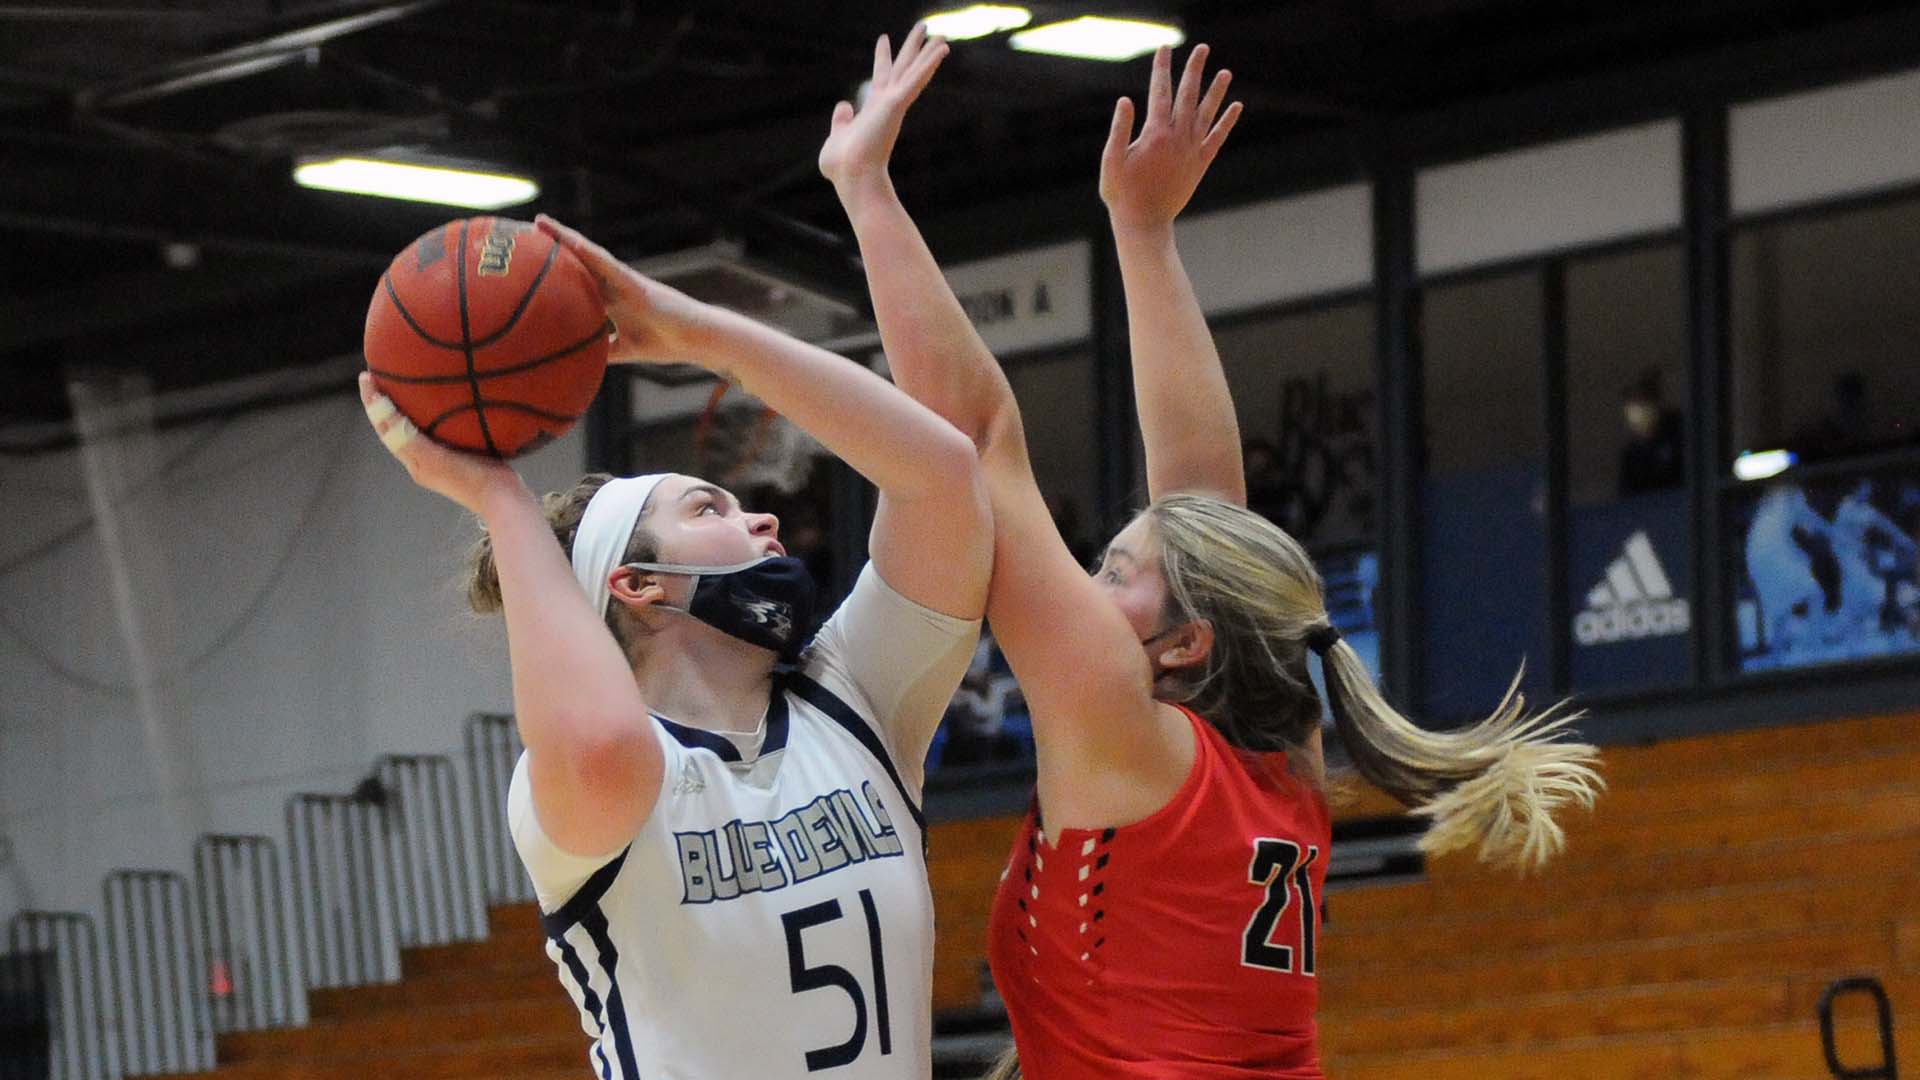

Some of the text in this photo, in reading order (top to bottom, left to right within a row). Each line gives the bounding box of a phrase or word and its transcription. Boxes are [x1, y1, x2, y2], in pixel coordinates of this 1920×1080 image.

[1574, 598, 1691, 645] adidas
[673, 819, 788, 905] BLUE
[1240, 837, 1318, 977] 21
[781, 888, 892, 1073] 51
